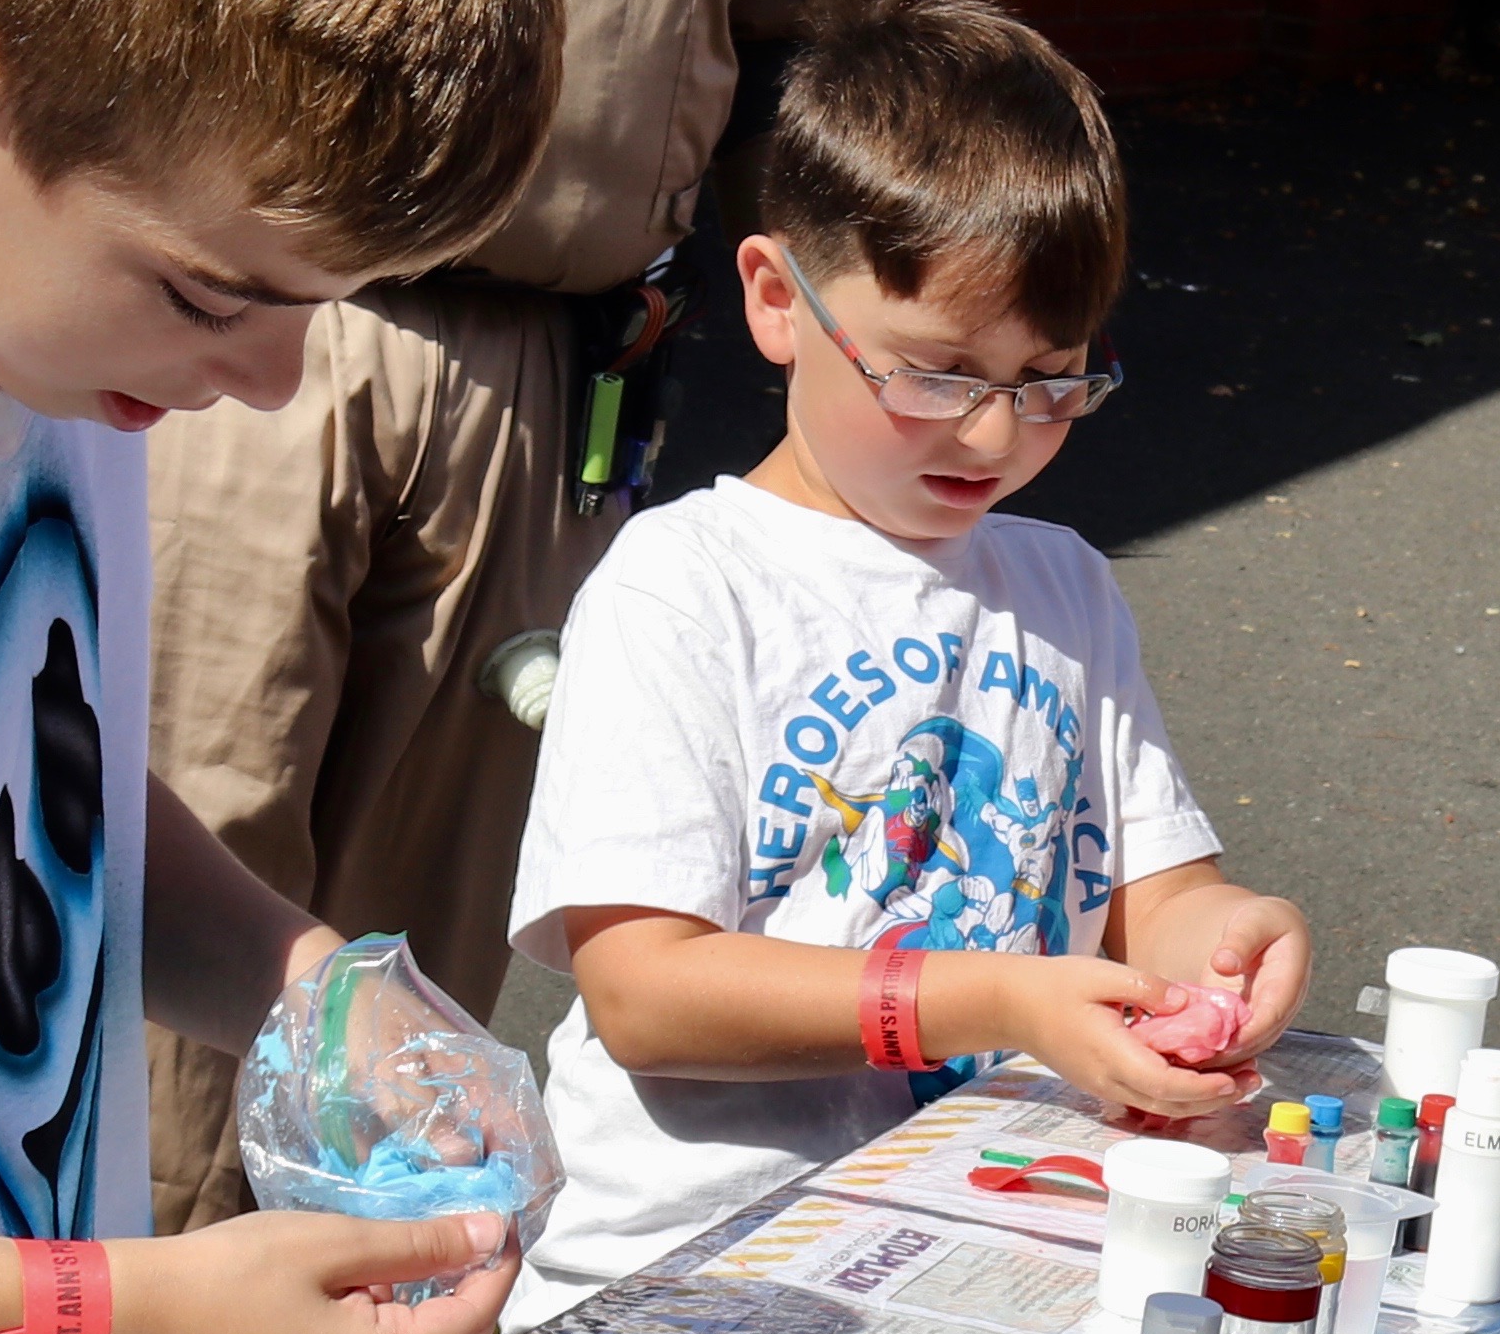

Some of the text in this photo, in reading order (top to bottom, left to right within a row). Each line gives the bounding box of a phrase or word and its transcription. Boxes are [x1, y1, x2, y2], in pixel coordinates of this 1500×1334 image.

[747, 649, 898, 905] HEROES
[892, 631, 964, 685] OF
[880, 1015, 903, 1058] ANN'S
[53, 1255, 83, 1317] ANN'S
